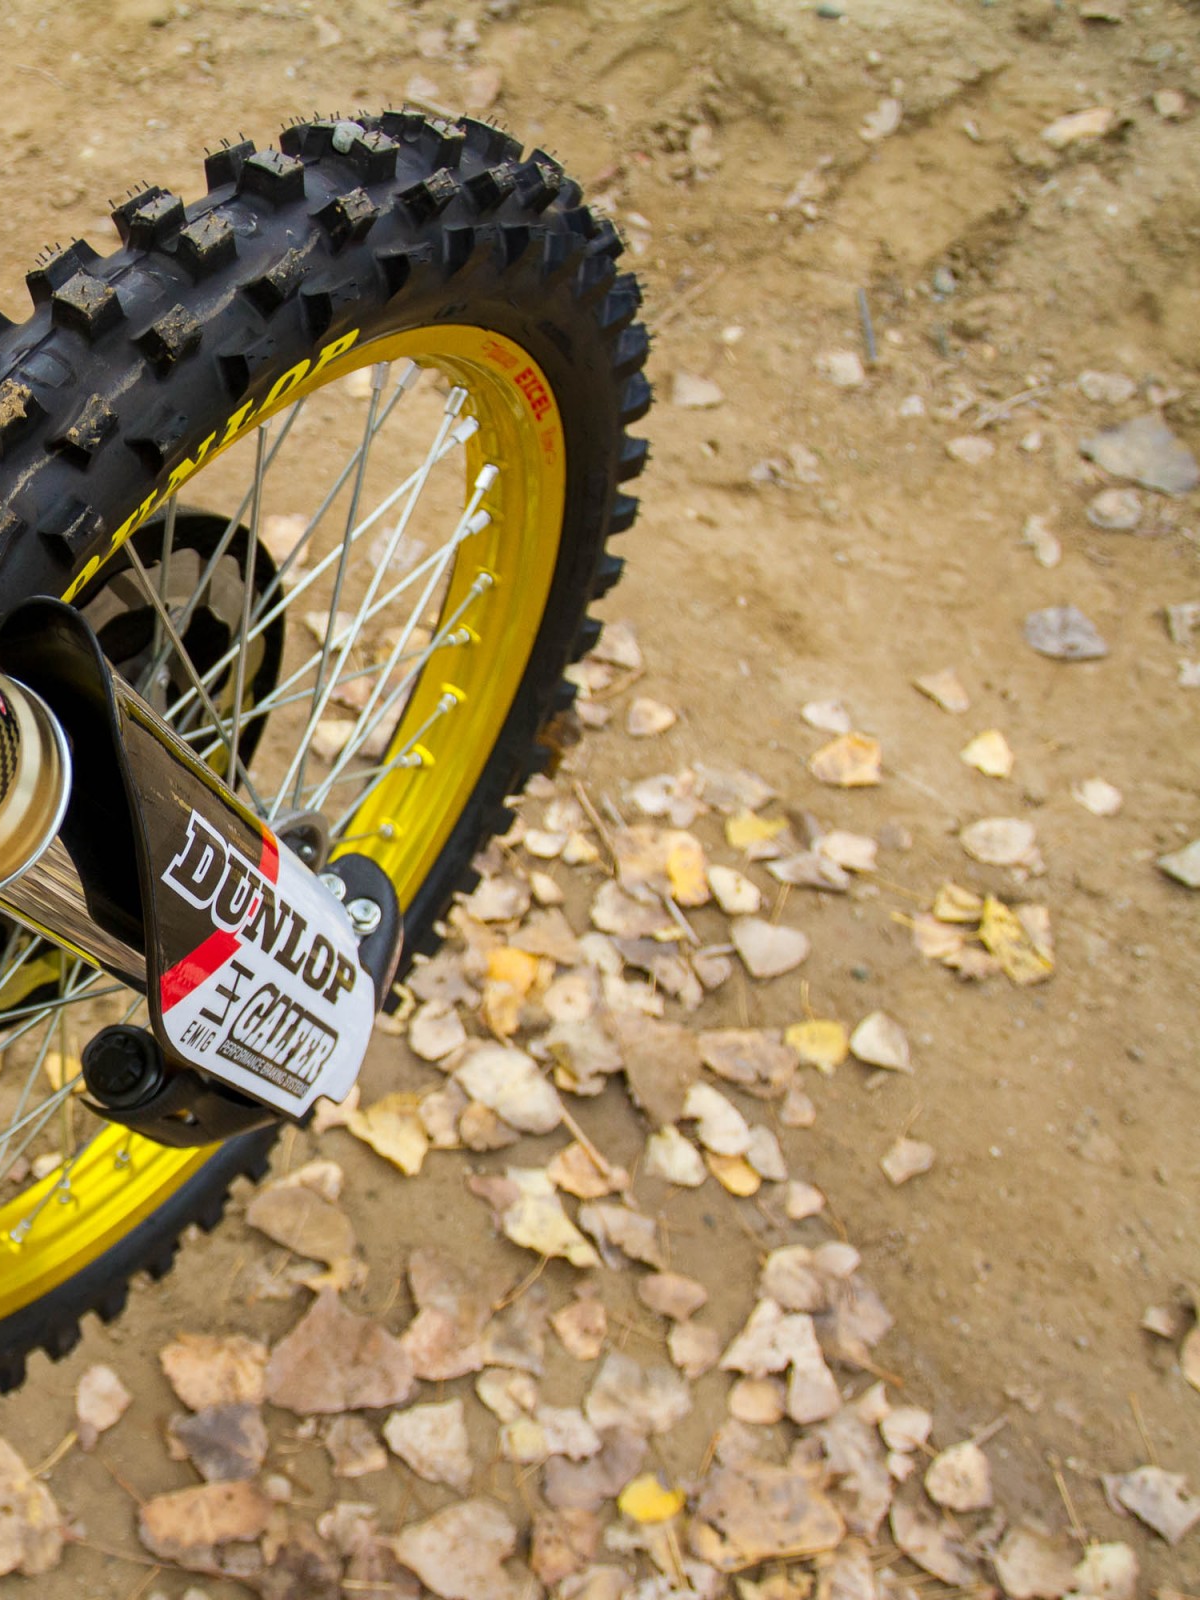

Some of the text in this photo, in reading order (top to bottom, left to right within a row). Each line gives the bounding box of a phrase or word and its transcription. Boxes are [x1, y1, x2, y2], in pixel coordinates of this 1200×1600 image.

[514, 367, 552, 422] EXCEL
[161, 809, 357, 1005] DUNLOP
[179, 1020, 217, 1053] EMIG
[231, 985, 338, 1085] GALFER
